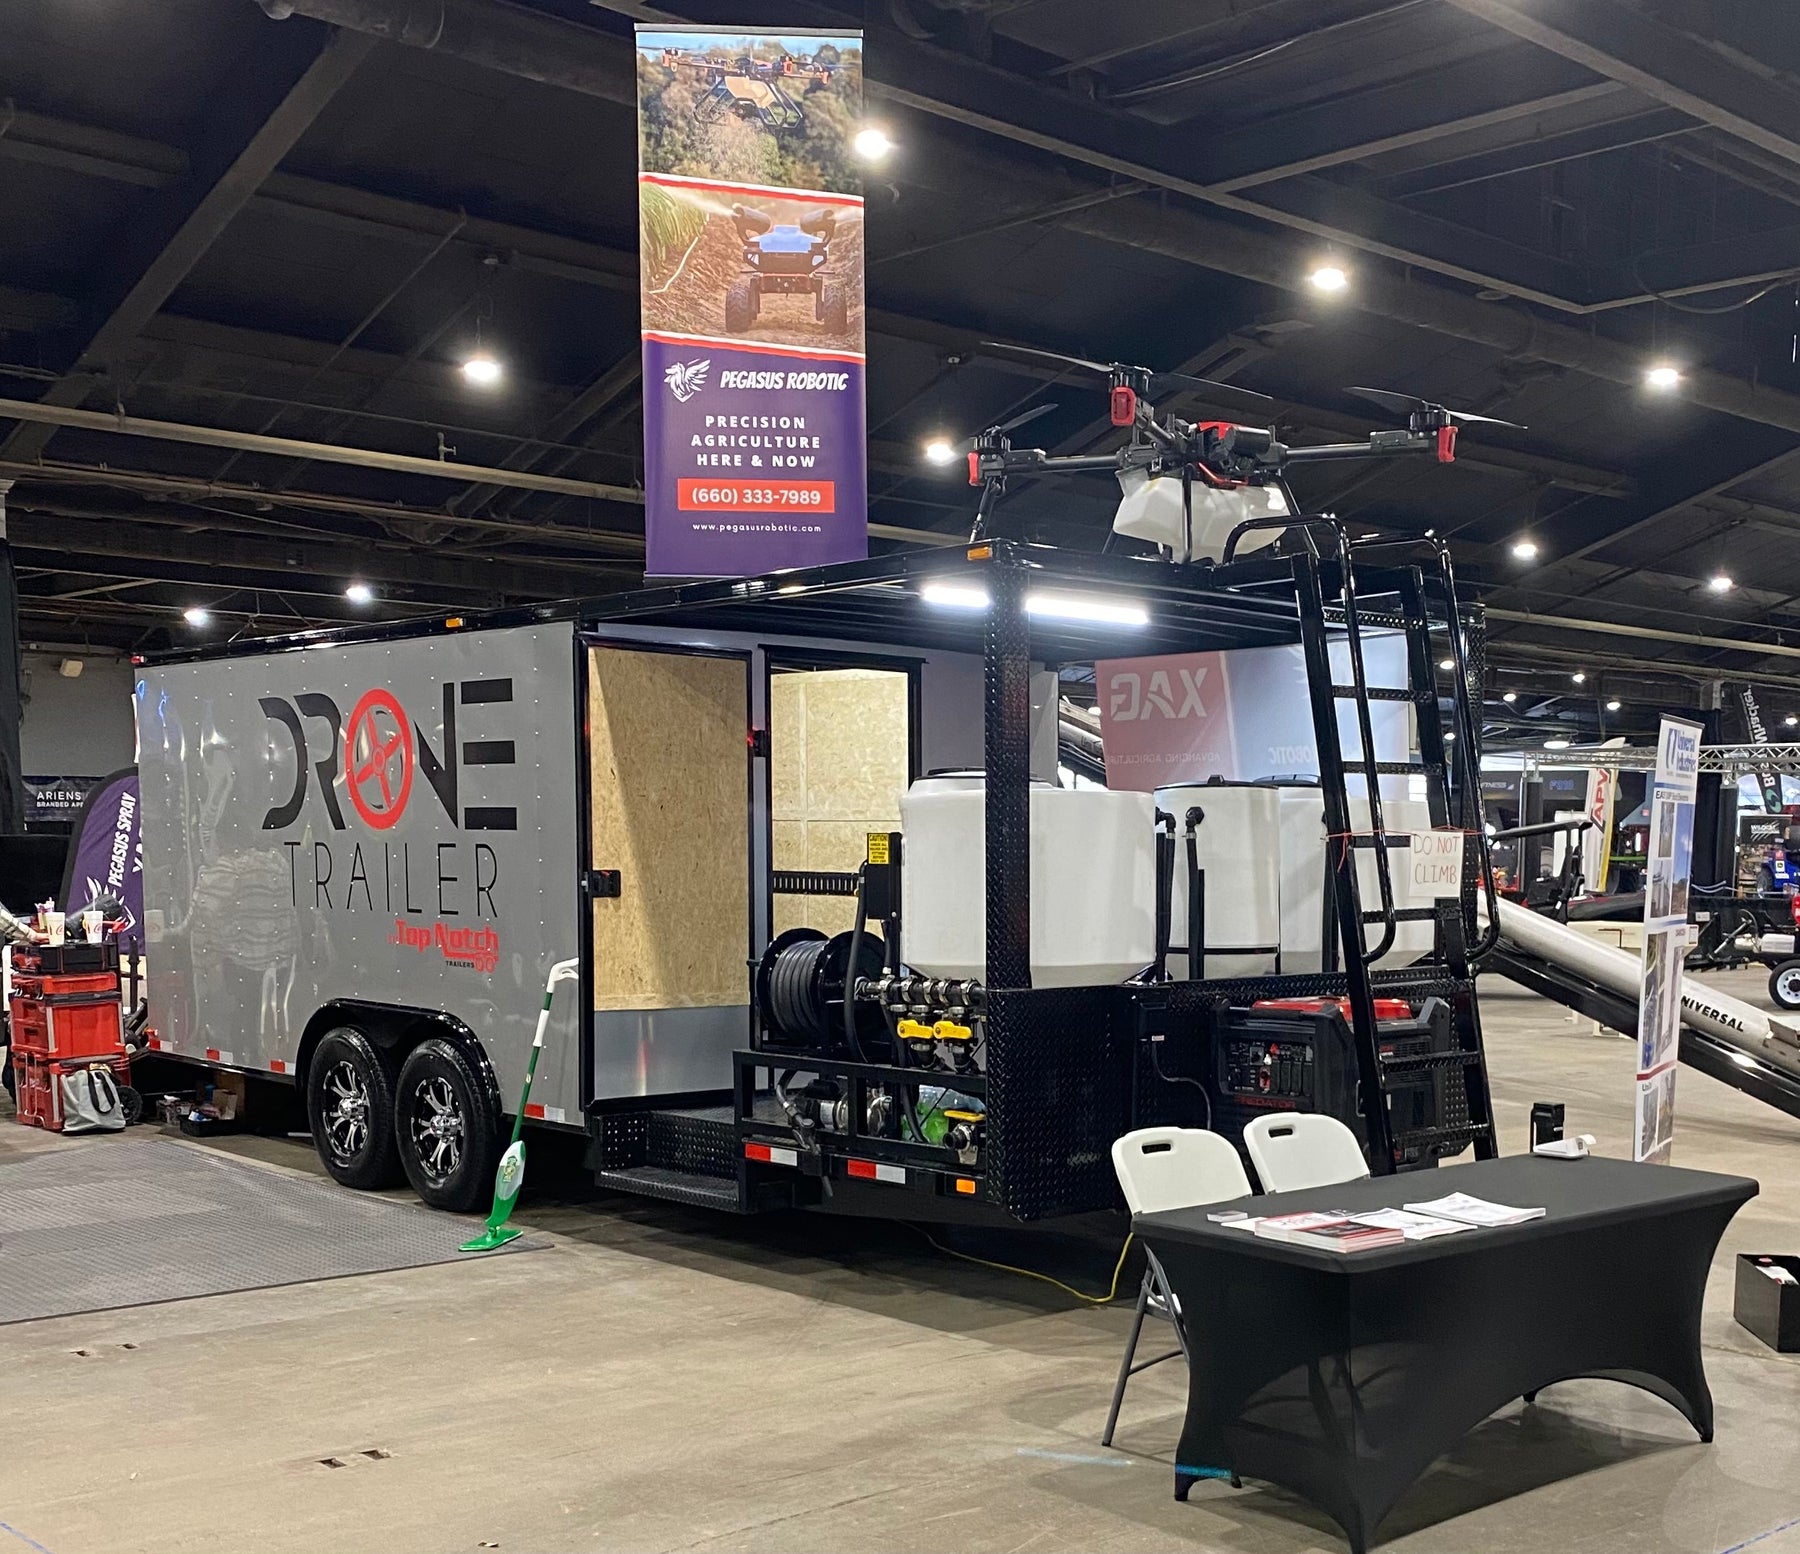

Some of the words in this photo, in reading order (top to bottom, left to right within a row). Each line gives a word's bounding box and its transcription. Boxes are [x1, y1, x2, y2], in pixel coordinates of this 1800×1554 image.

[719, 370, 784, 391] PEGASUS
[786, 371, 849, 392] ROBOTIC
[705, 415, 806, 429] PRECISION
[690, 434, 821, 449] AGRICULTURE
[696, 453, 742, 467] HERE
[750, 454, 763, 467] &
[772, 455, 816, 468] NOW
[692, 487, 738, 505] (660)
[742, 488, 821, 505] 333-7989
[692, 522, 822, 533] www.pegasusrobotic.com
[257, 677, 518, 832] DRONE
[36, 791, 82, 801] ARIENS
[1593, 767, 1609, 821] APV
[116, 791, 137, 832] SPRAY
[1413, 834, 1433, 856] DO
[1437, 835, 1461, 854] NOT
[108, 831, 130, 888] PEGASUS
[283, 841, 498, 918] TRAILER
[1414, 863, 1458, 885] CLIMB
[434, 922, 499, 958] Notch
[445, 960, 475, 969] TRAILERS
[1680, 994, 1745, 1033] NIVERSAL
